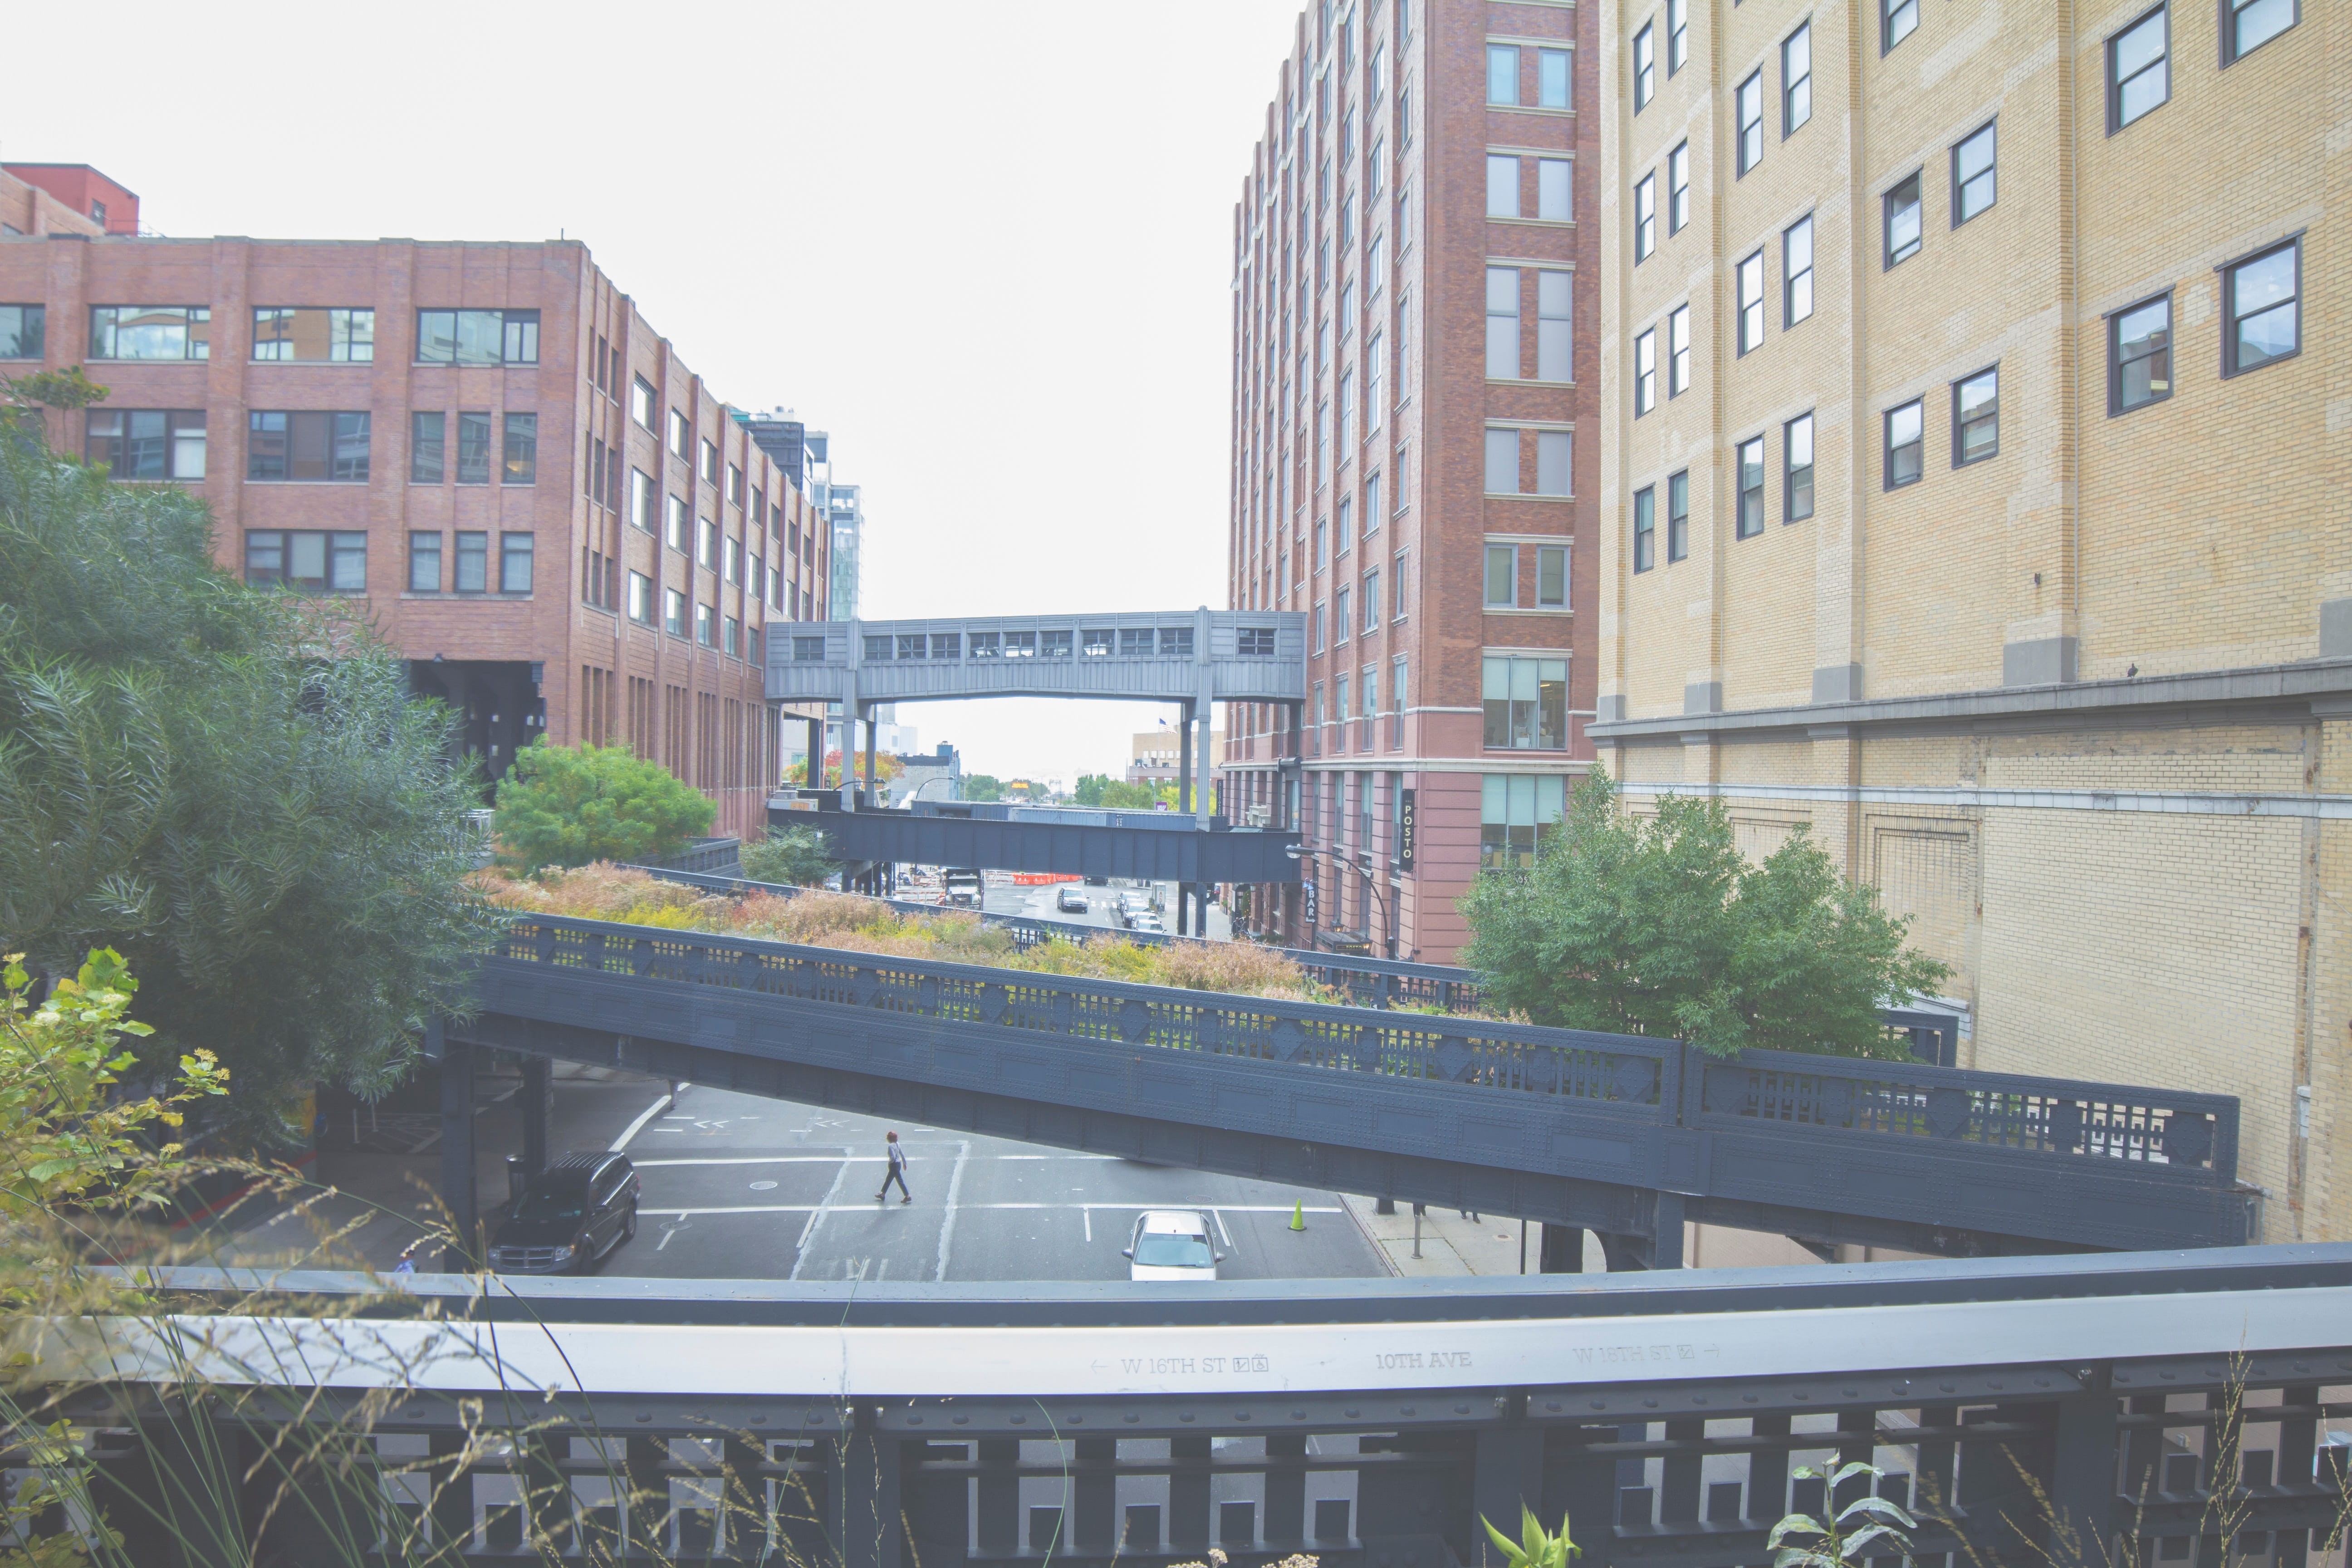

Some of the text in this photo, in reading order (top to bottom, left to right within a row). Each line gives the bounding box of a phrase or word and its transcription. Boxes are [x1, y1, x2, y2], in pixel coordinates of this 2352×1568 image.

[1403, 805, 1412, 858] POSTO
[1307, 890, 1315, 916] BAR
[1375, 1352, 1473, 1369] 10TH AVE
[1572, 1348, 1594, 1363] W
[1649, 1345, 1671, 1361] ST
[1121, 1357, 1226, 1374] W 16TH ST
